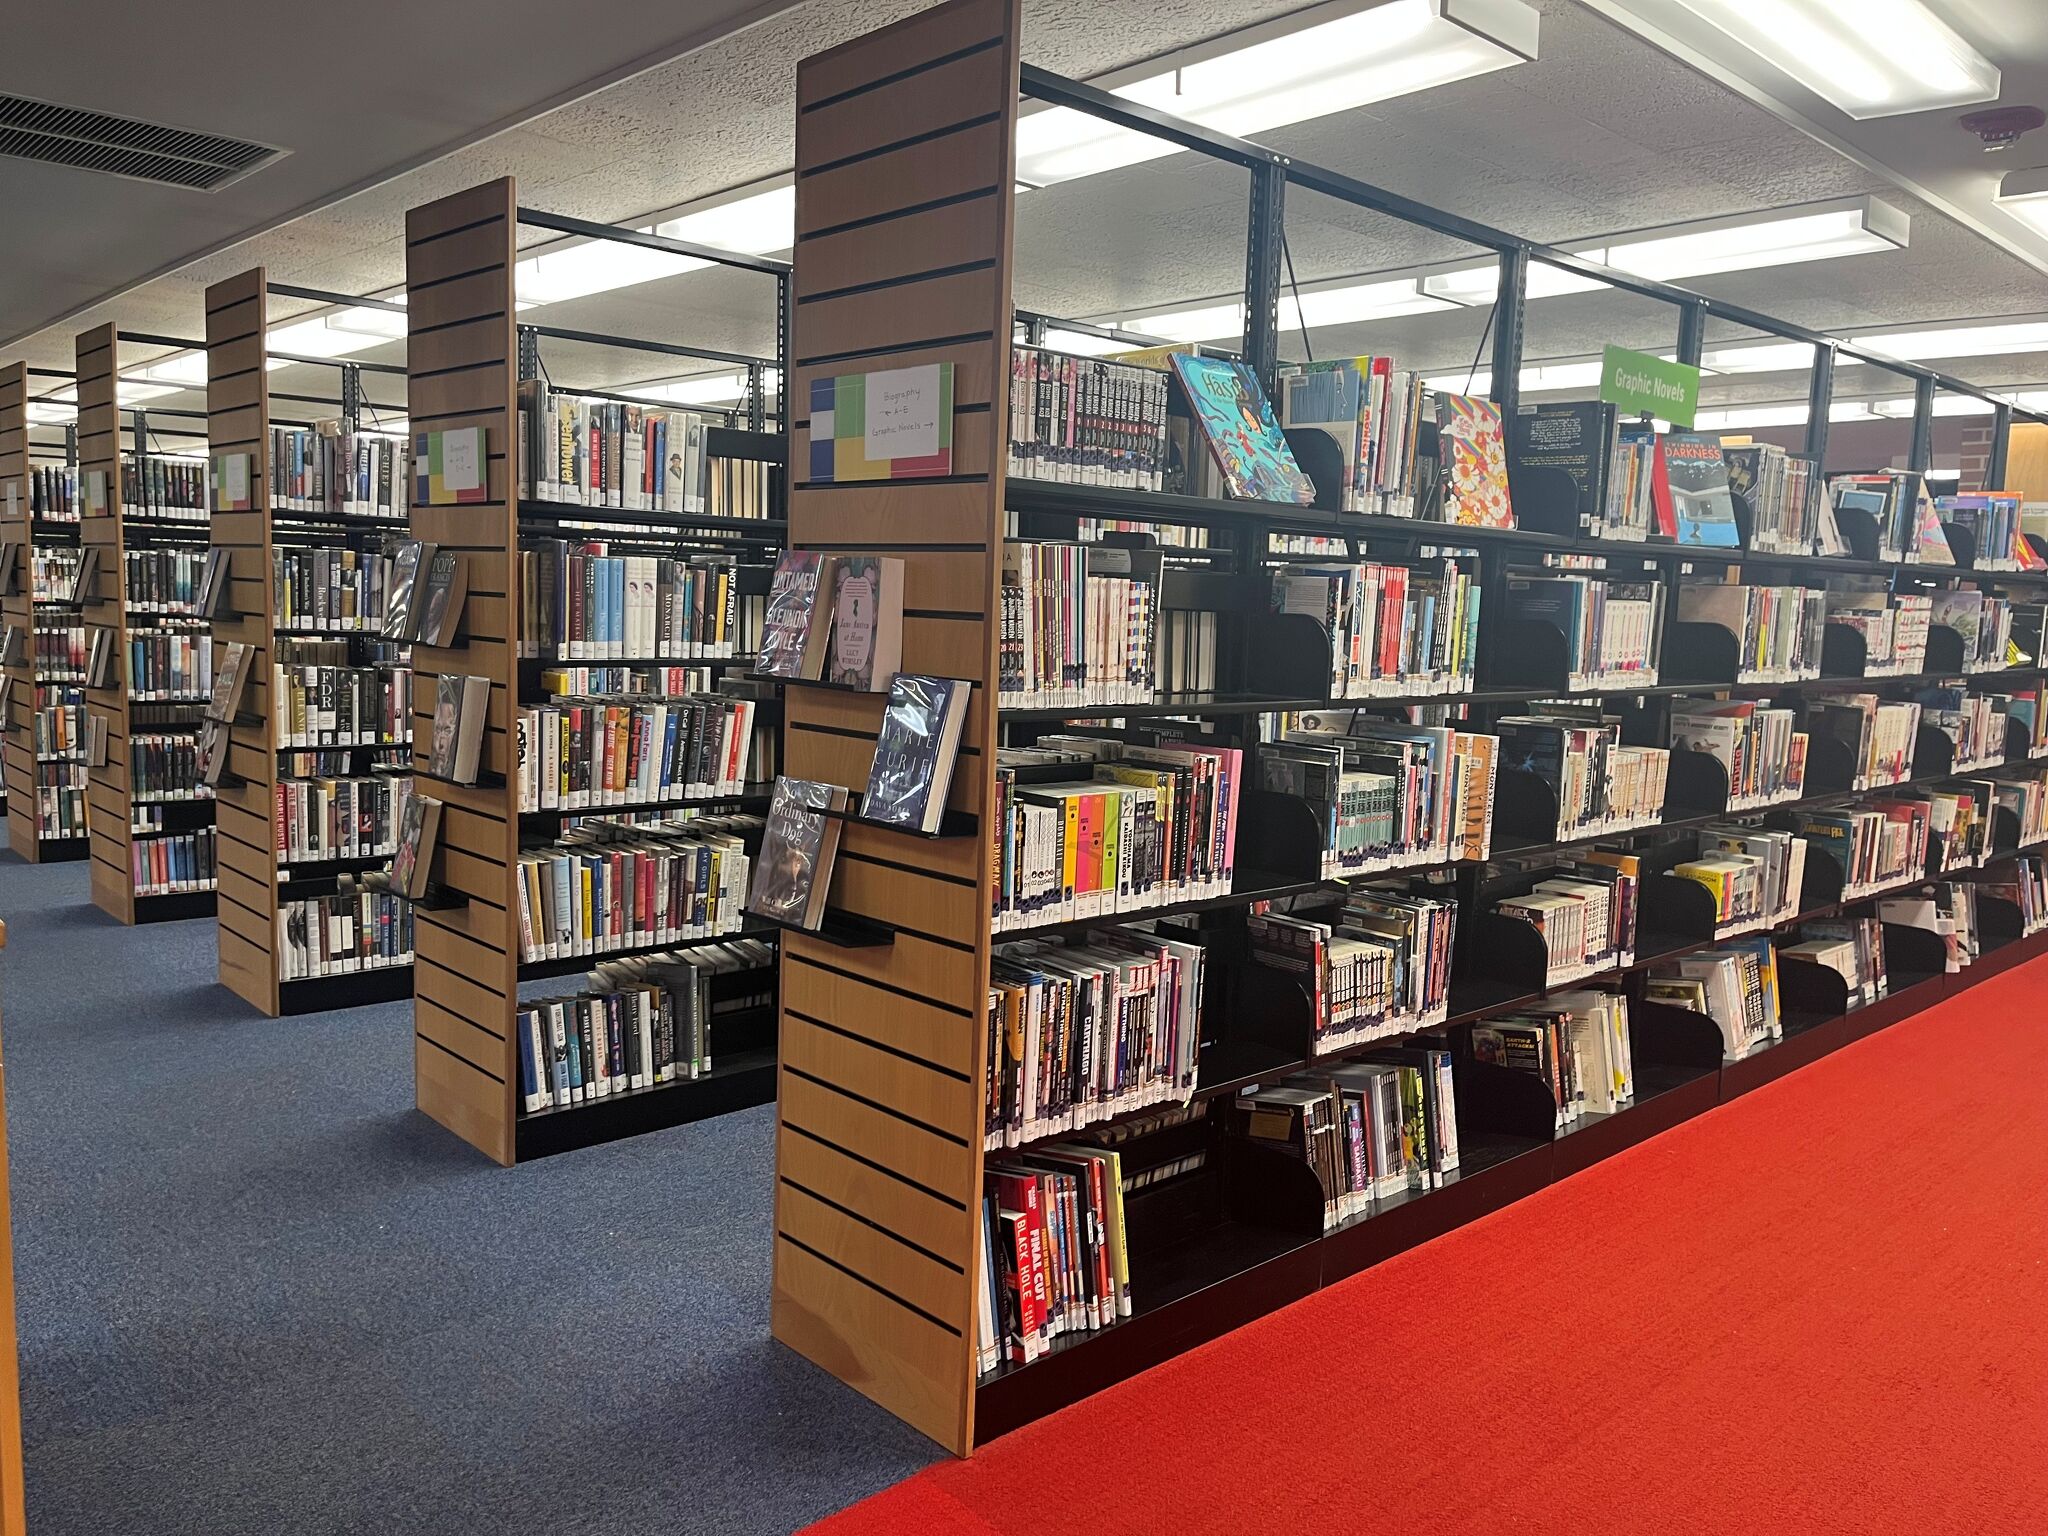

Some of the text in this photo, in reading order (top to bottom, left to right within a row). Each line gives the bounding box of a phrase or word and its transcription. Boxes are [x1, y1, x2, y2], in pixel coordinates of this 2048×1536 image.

[883, 388, 921, 405] Biography
[1615, 367, 1685, 403] Graphic Novels
[871, 423, 921, 437] Graphic Novels
[1362, 410, 1370, 459] MONICA
[1664, 447, 1721, 460] DARKNESS
[726, 568, 736, 625] NOT AFRAID
[321, 672, 332, 708] FDR
[683, 709, 688, 717] On
[629, 718, 641, 779] the four tops
[642, 720, 651, 762] Anna Faris
[678, 740, 686, 761] Anthony
[693, 727, 702, 742] Girl
[882, 724, 936, 750] MARIE
[874, 748, 930, 775] CURIE
[1733, 749, 1742, 794] BERLIN
[1462, 765, 1470, 822] MONSTERS
[1487, 766, 1495, 824] MONSTERS
[772, 797, 821, 828] Ordinary
[781, 821, 804, 846] Dog
[1056, 820, 1064, 861] DOWNFALL
[702, 852, 708, 863] MY
[992, 843, 1000, 886] DRAGMAN
[554, 1008, 562, 1032] FORTUNATE
[630, 995, 638, 1015] Betty
[1082, 1016, 1091, 1075] CARTHAGO
[559, 1064, 567, 1075] JOHN
[1354, 1146, 1362, 1187] SANPAKU
[1017, 1220, 1031, 1300] BLACK HOLE
[1030, 1229, 1044, 1301] FINAL CUT
